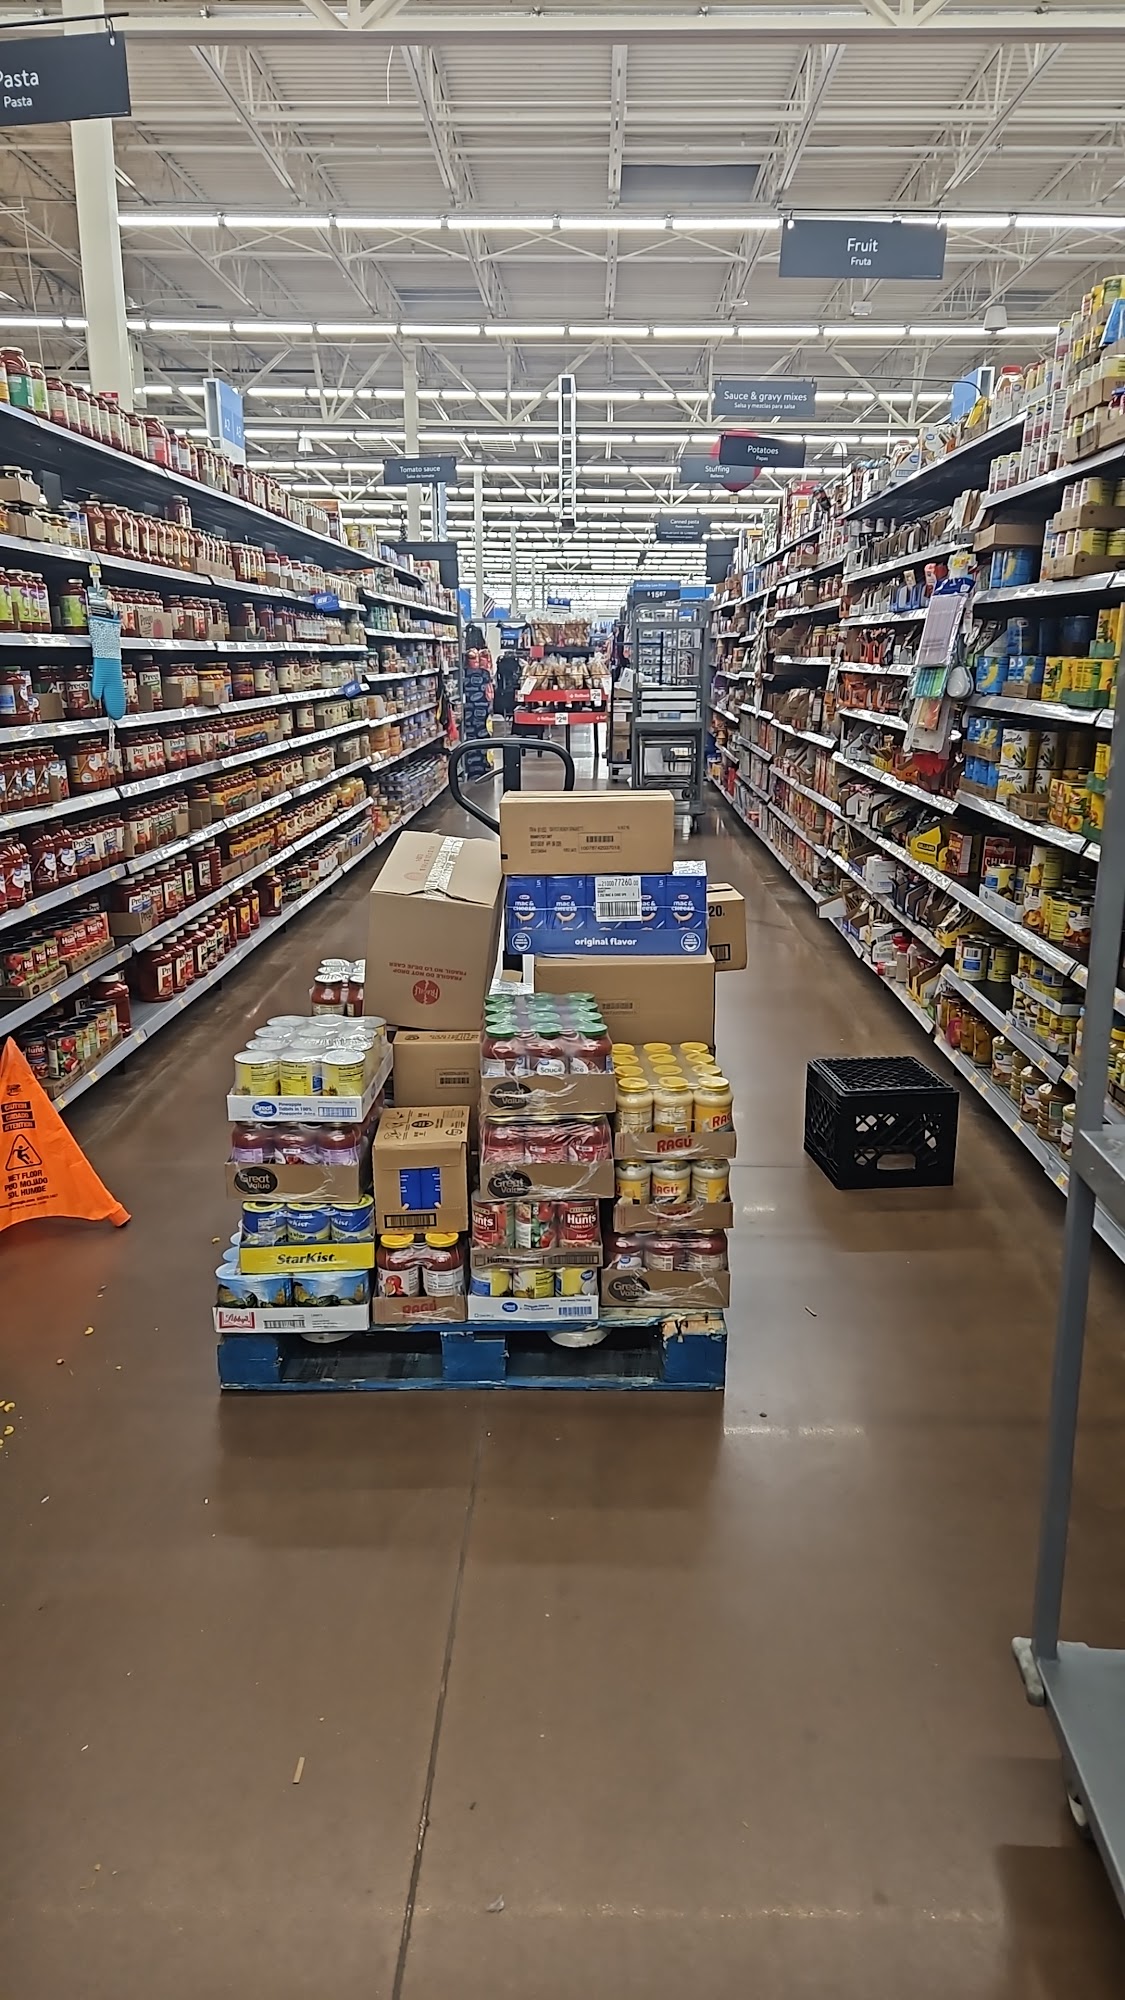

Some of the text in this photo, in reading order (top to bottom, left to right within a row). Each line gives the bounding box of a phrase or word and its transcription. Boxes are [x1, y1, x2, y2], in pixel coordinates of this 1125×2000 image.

[3, 96, 33, 108] Pasta
[847, 238, 879, 252] Fruit
[850, 256, 872, 266] Fruta
[723, 391, 808, 403] Sauce & gravy mixes
[747, 445, 779, 455] Potatoes
[705, 465, 730, 474] Stuffing
[73, 836, 94, 848] Prego
[574, 937, 638, 947] original flavor
[436, 973, 463, 981] FRAGILE
[540, 1066, 562, 1074] Sauce
[4, 1103, 27, 1111] CAUTION
[657, 1135, 693, 1153] RAGÚ
[8, 1170, 43, 1183] WET FLOOR
[239, 1173, 270, 1184] Great
[20, 1177, 48, 1189] MOJADO
[248, 1181, 271, 1189] Value
[493, 1177, 524, 1188] Great
[501, 1186, 524, 1194] Value
[567, 1213, 597, 1224] Hunt's
